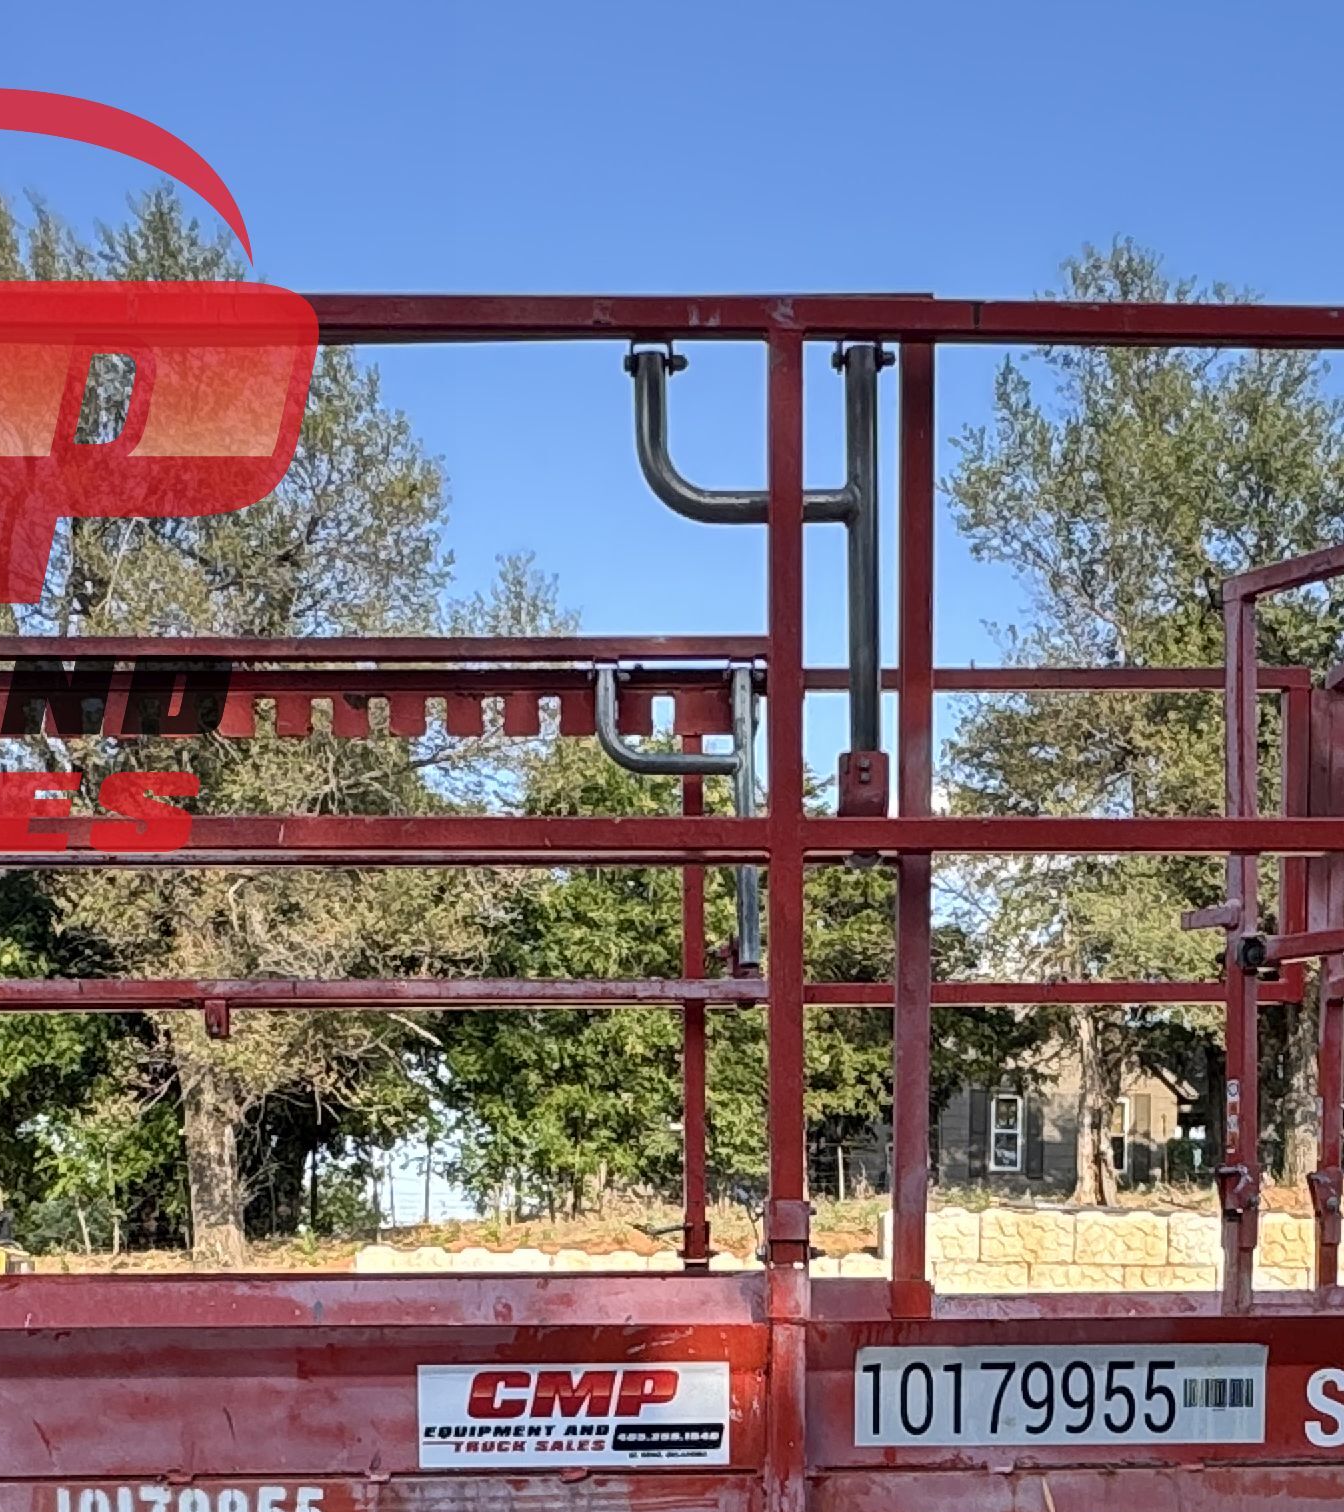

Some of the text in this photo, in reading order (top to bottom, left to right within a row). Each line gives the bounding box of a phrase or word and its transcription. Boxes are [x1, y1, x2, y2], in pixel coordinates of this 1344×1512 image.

[467, 1371, 679, 1418] CMP
[862, 1360, 1177, 1436] 10179955
[424, 1424, 610, 1438] EQUIPMENT AND
[455, 1440, 605, 1452] TRUCK SALES
